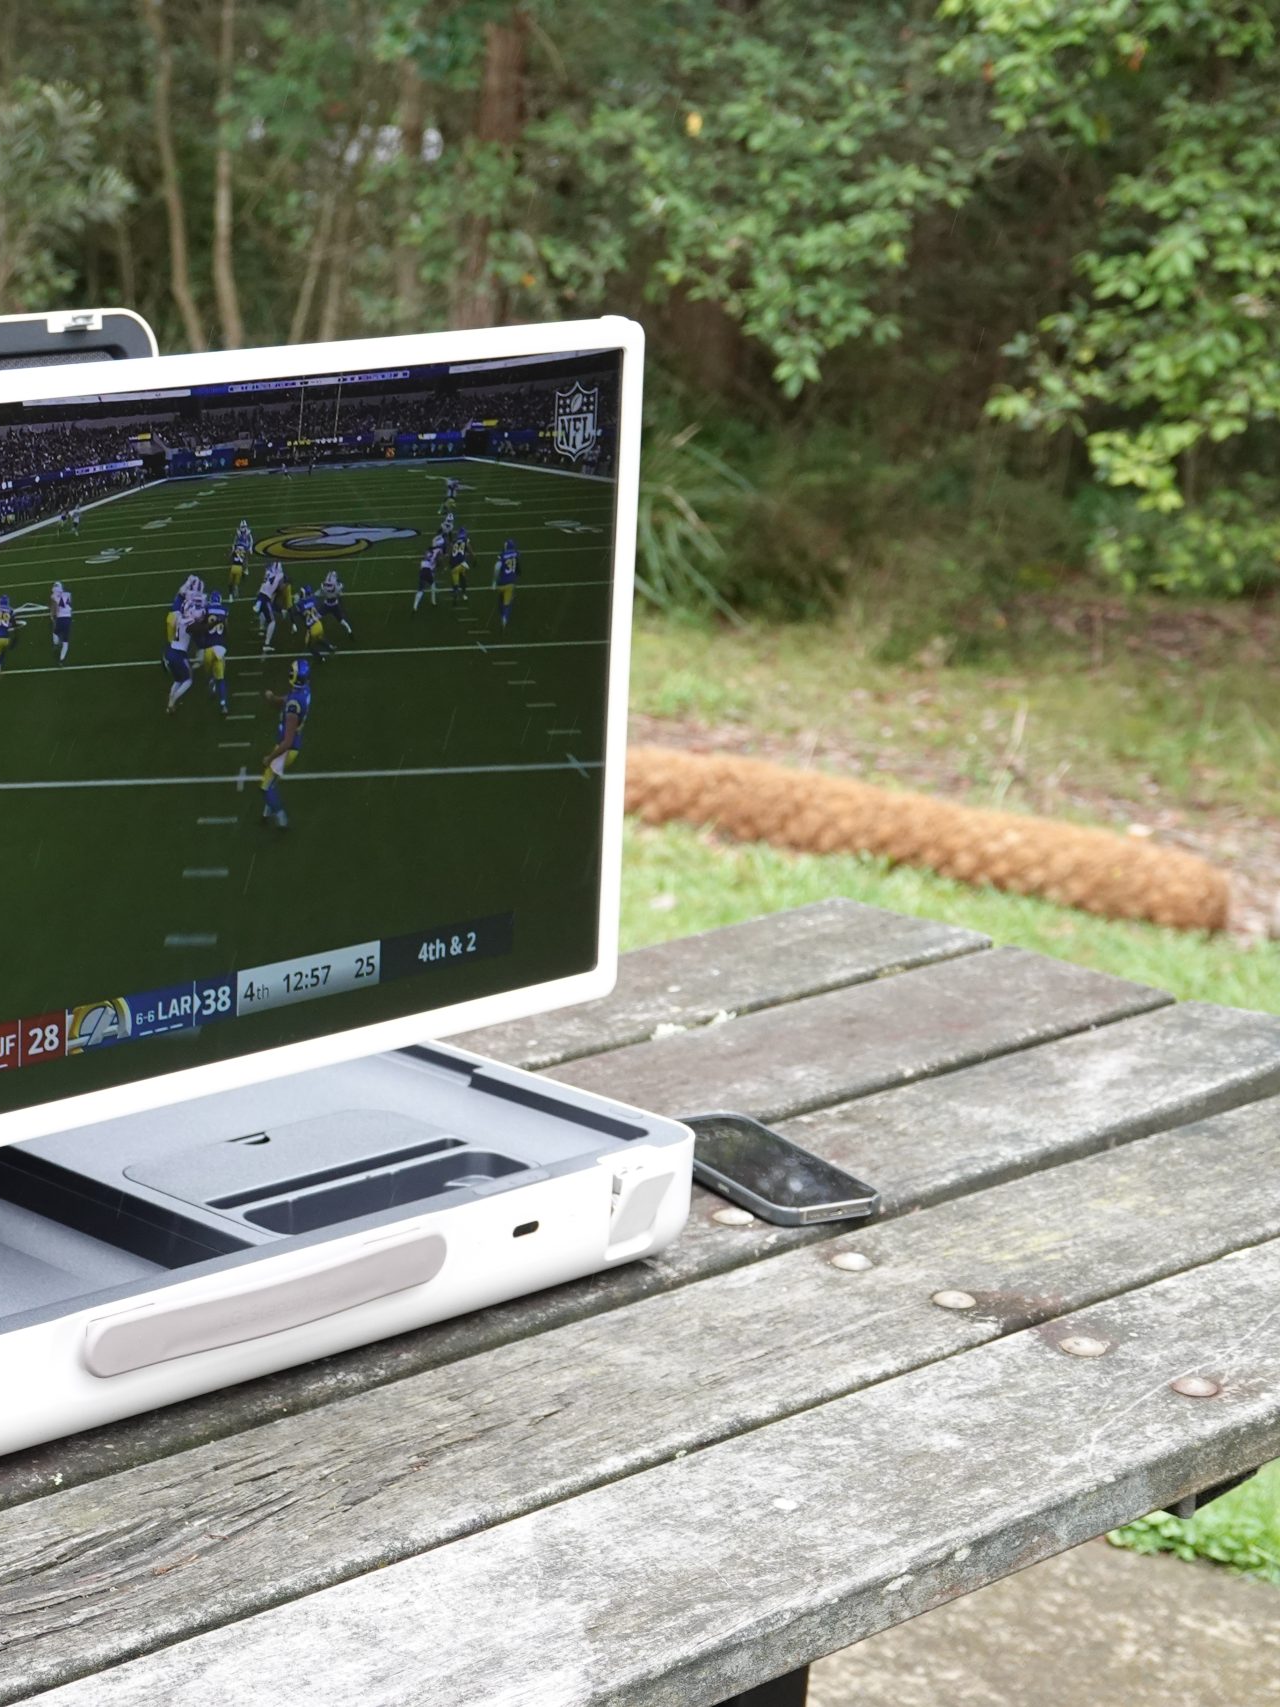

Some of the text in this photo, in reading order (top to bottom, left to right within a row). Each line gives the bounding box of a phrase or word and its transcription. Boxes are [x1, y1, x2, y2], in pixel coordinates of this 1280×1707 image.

[560, 415, 592, 450] NFL
[417, 931, 477, 963] 4th & 2
[243, 955, 376, 1002] 4th 12:57 25
[136, 986, 232, 1026] 6-6 LAR 38
[28, 1024, 59, 1056] 28
